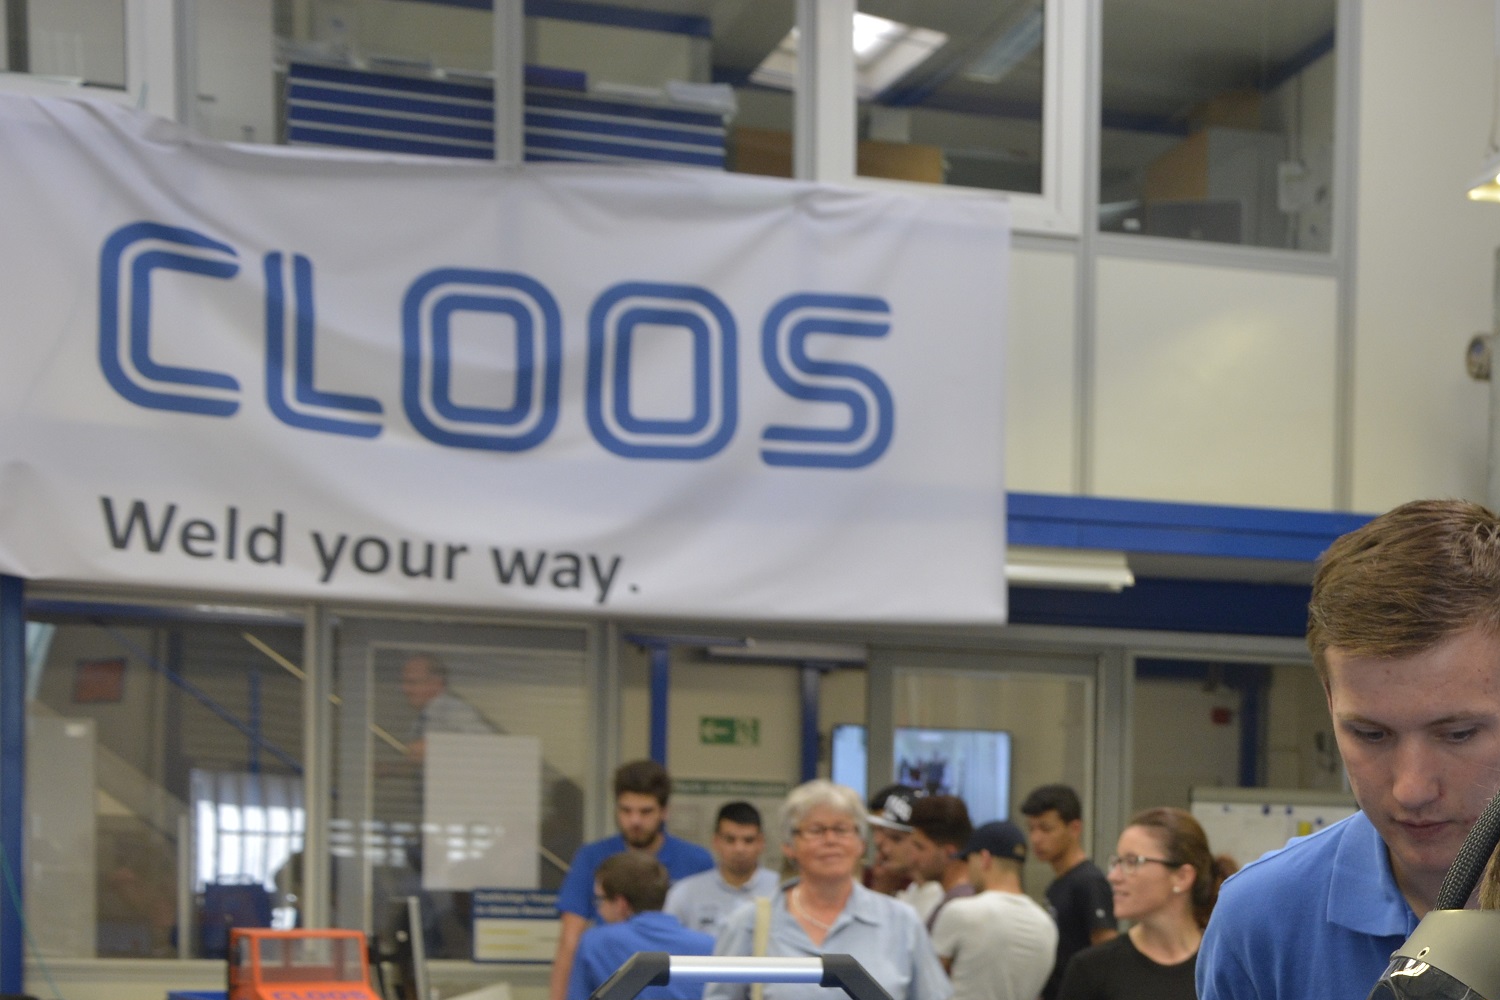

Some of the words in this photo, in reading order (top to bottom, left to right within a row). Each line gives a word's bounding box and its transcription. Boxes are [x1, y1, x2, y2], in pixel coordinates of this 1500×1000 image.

[99, 220, 895, 471] CLOOS
[100, 494, 287, 567] Weld
[310, 529, 471, 586] your
[489, 544, 641, 606] way.
